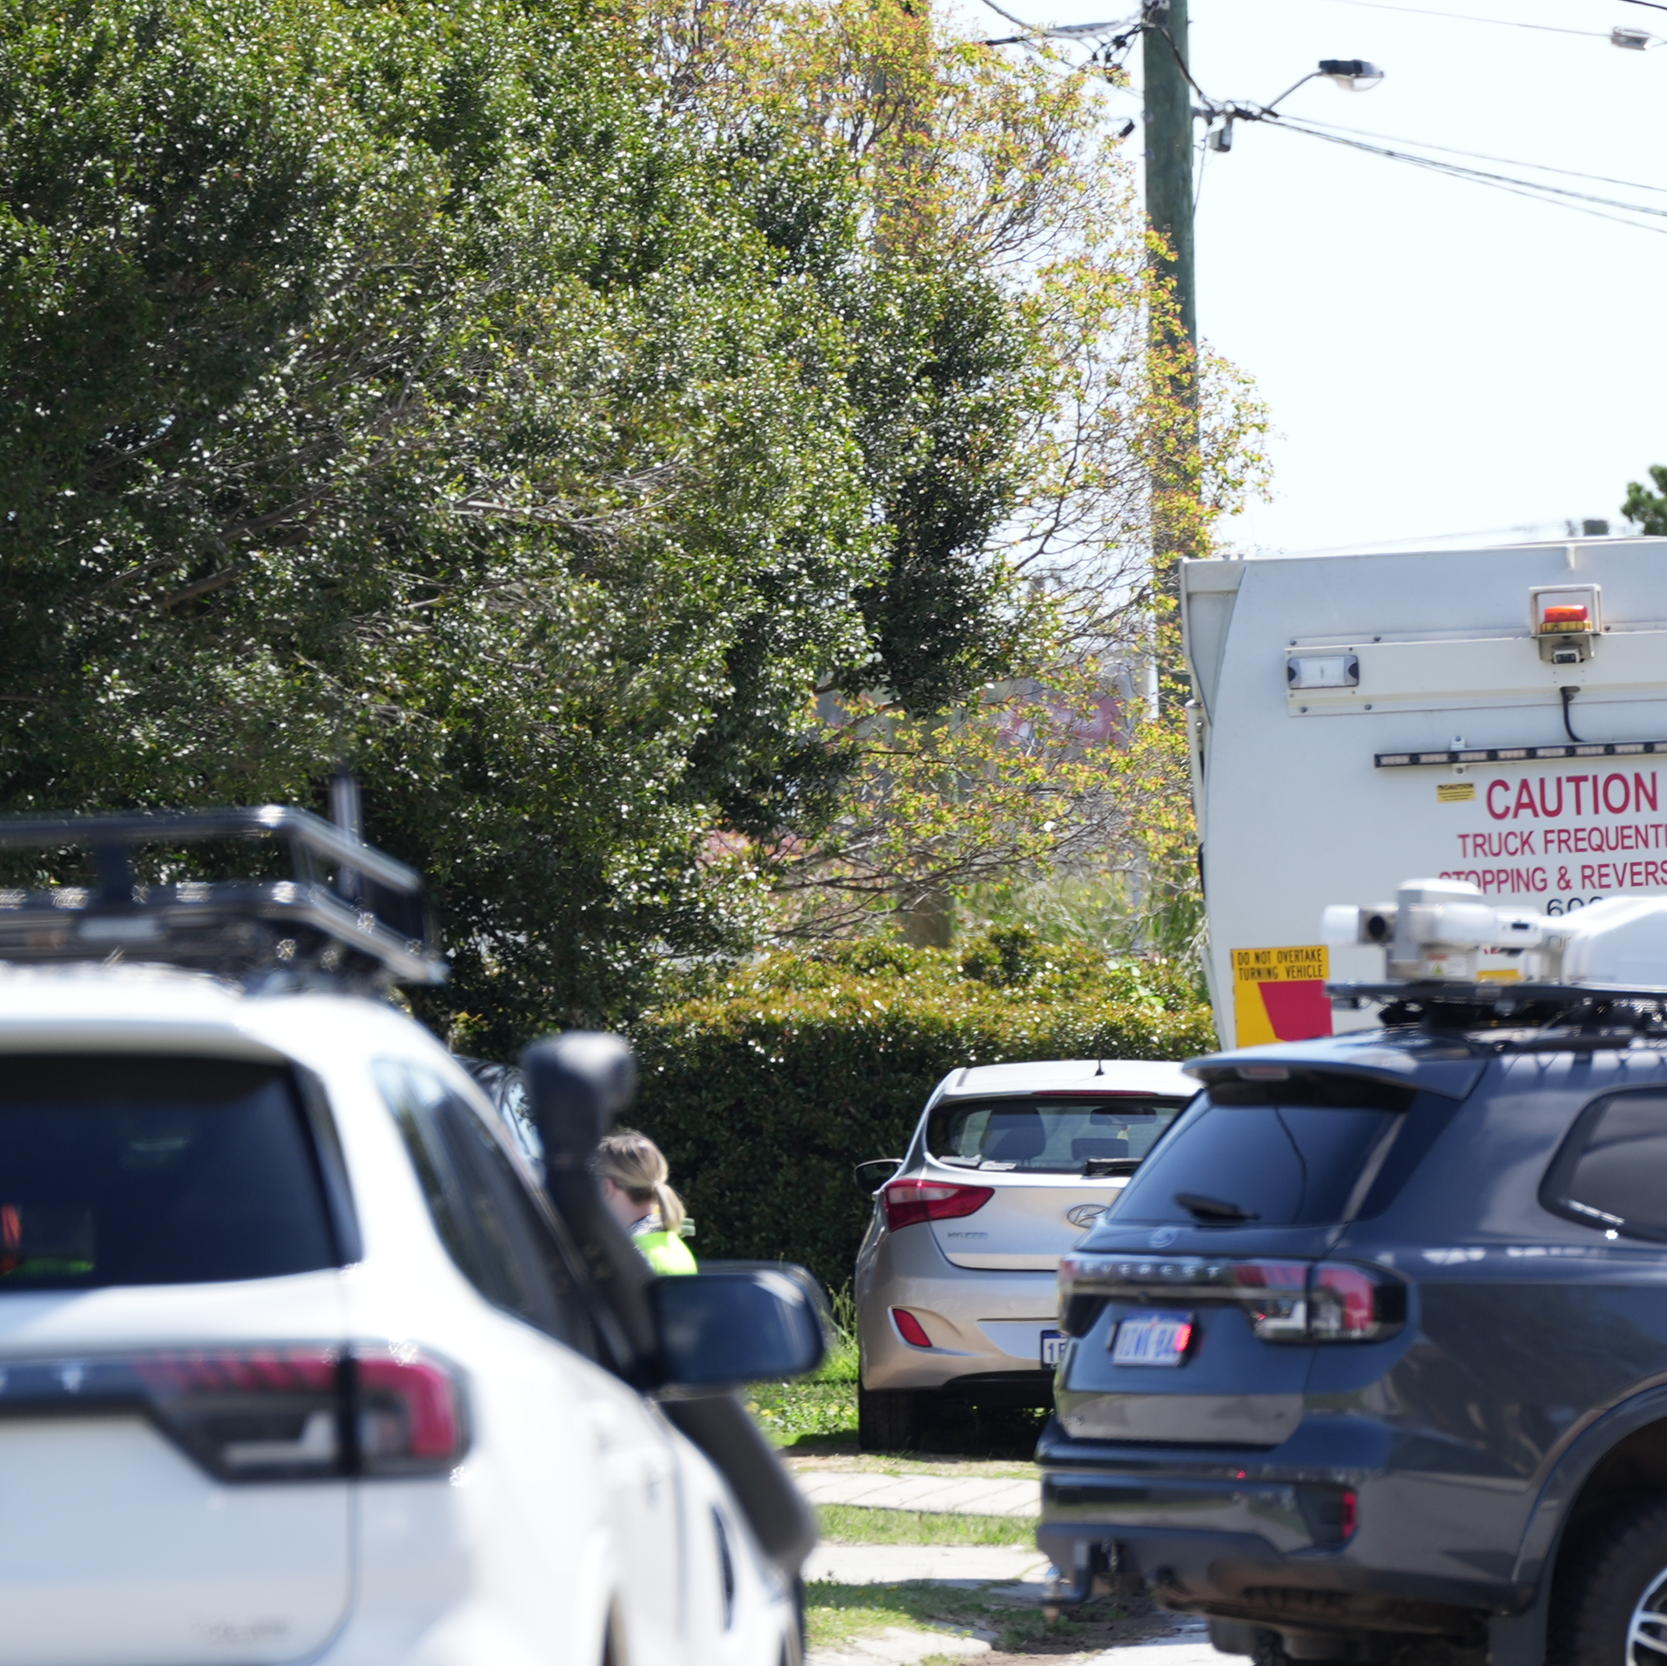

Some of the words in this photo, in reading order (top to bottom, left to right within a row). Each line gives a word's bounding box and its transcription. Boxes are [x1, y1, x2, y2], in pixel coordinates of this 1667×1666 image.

[1486, 771, 1658, 820] CAUTION
[1456, 830, 1536, 859] TRUCK
[1556, 865, 1573, 891] &
[1238, 952, 1250, 965] DO
[1254, 951, 1272, 965] NOT
[1277, 949, 1322, 963] OVERTAKE
[1239, 966, 1278, 980] TURNING
[1285, 964, 1323, 978] VEHICLE
